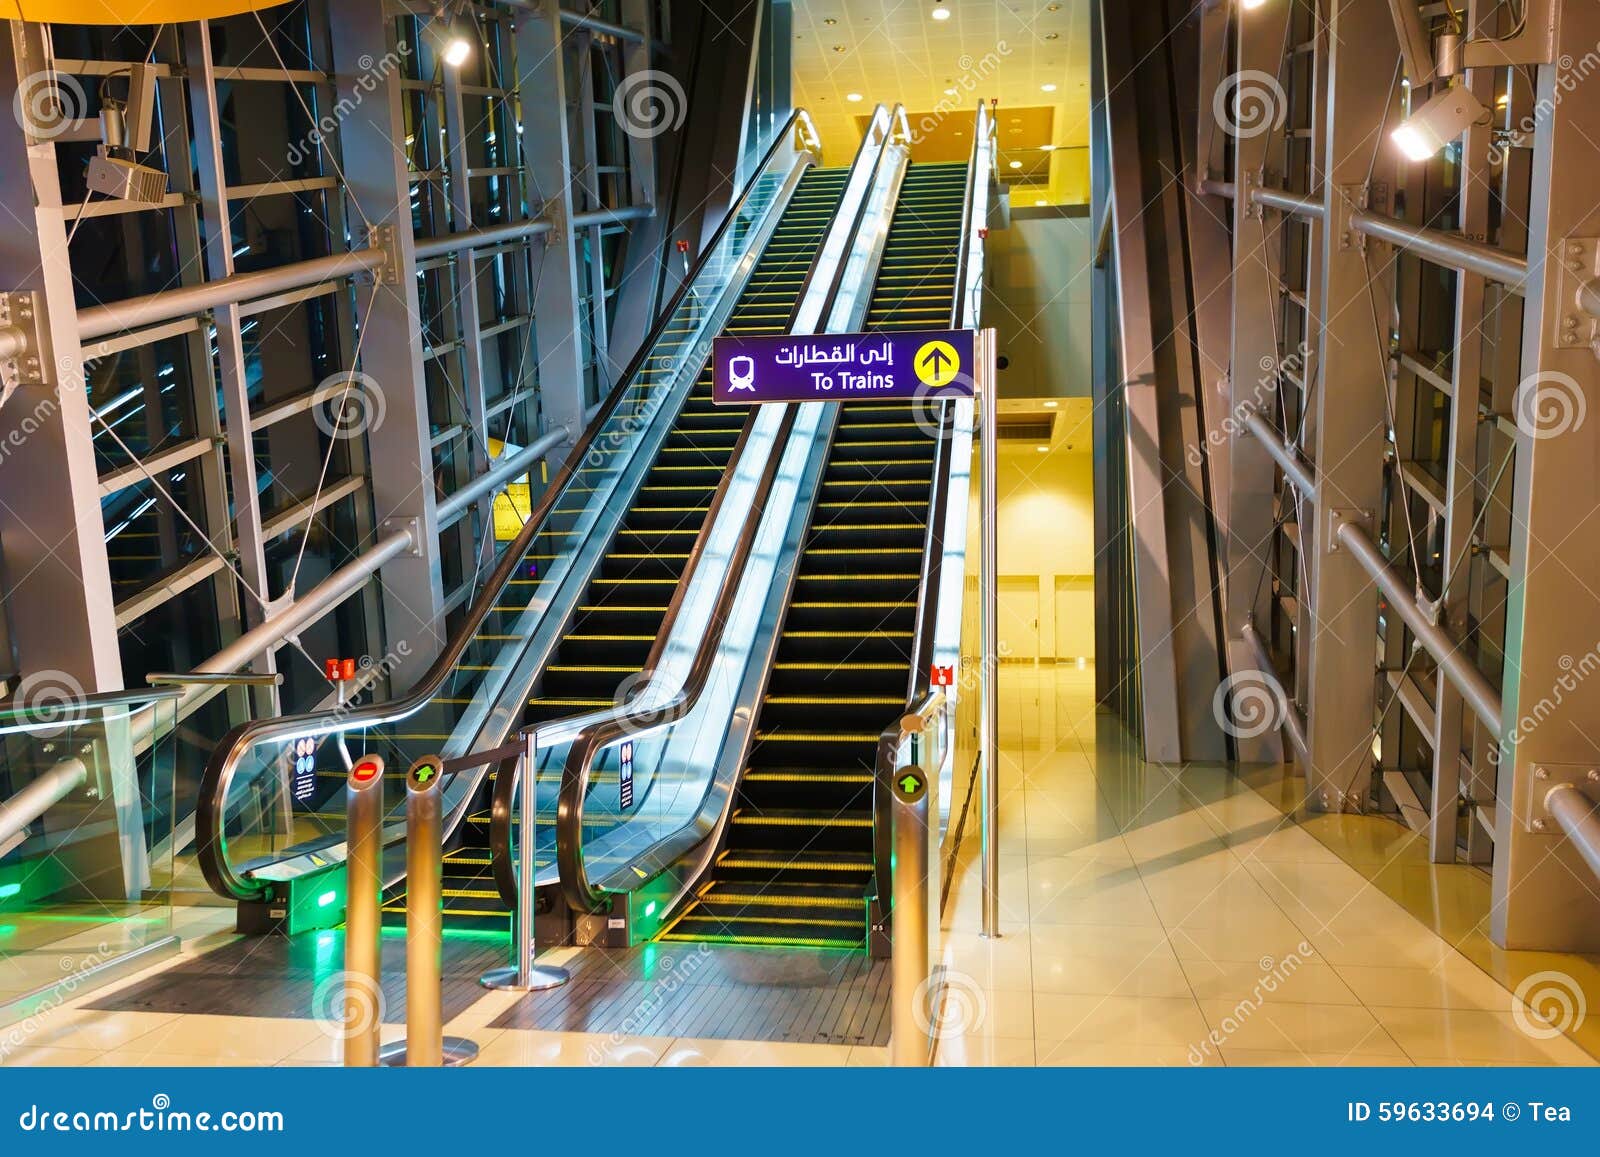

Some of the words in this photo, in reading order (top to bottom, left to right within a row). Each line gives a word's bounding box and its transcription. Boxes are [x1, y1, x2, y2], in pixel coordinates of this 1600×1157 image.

[775, 343, 855, 369] القطارات
[859, 342, 894, 366] إلى
[811, 372, 834, 391] To
[837, 371, 895, 390] Trains
